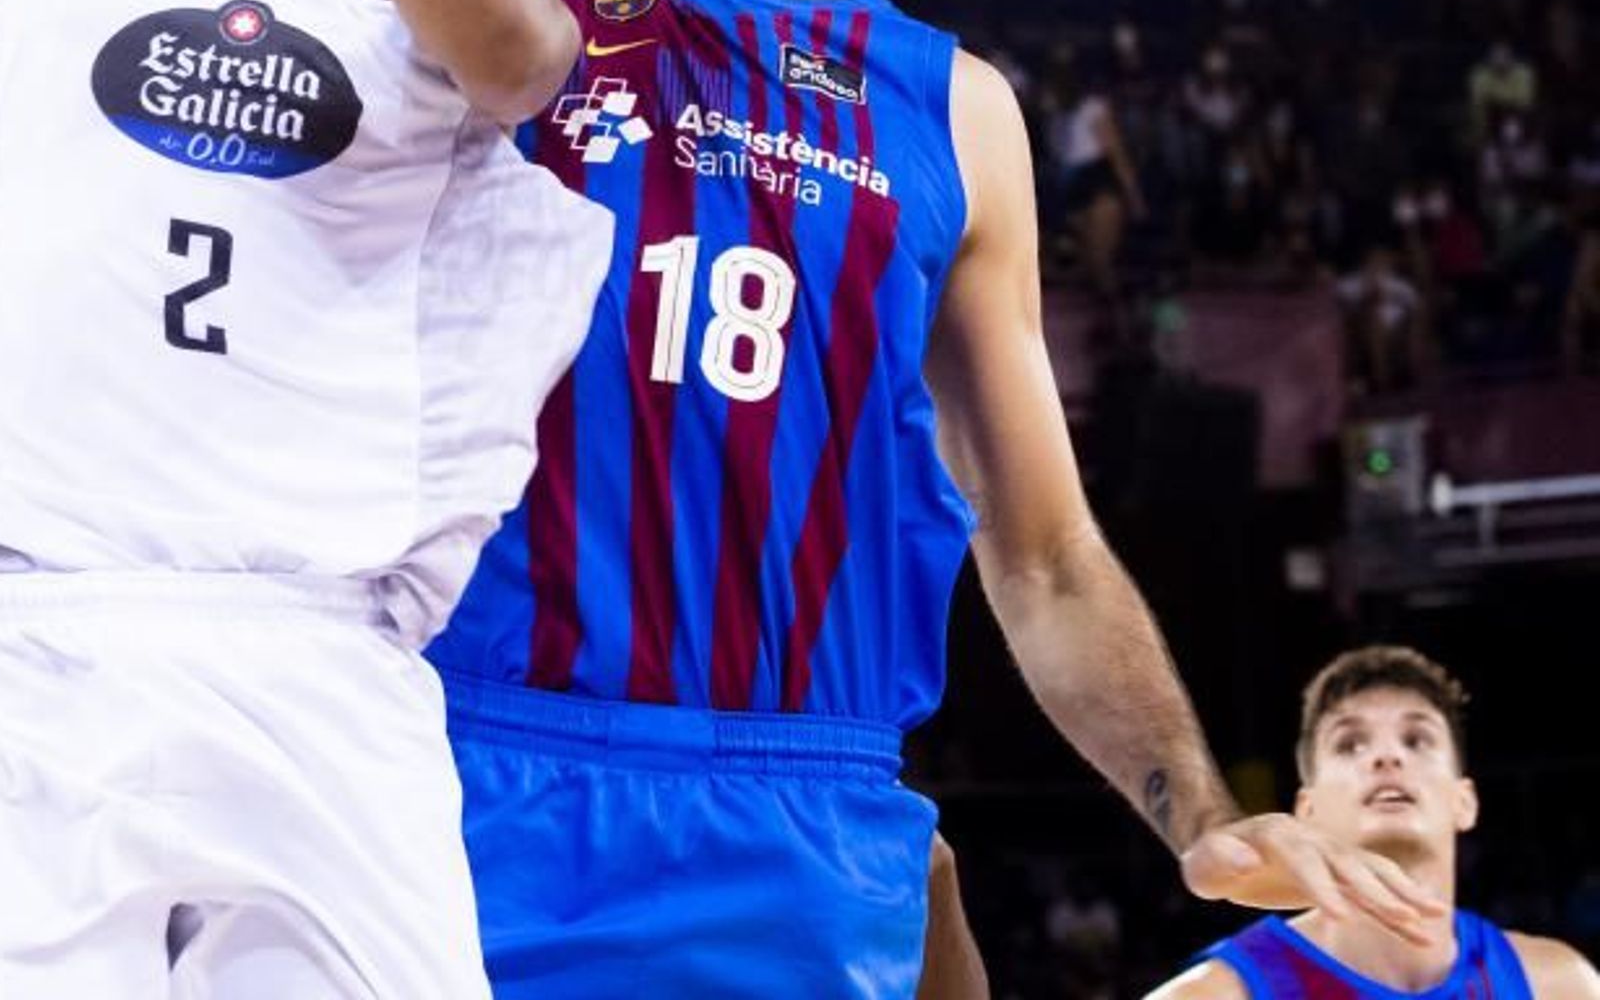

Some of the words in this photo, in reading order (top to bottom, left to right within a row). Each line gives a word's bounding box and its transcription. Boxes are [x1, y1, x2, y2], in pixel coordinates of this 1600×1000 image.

[139, 31, 320, 101] Estrella
[139, 75, 305, 142] Galicia
[674, 103, 892, 198] Assistència
[674, 135, 823, 206] Sanitària
[164, 217, 233, 355] 2
[640, 234, 797, 402] 18
